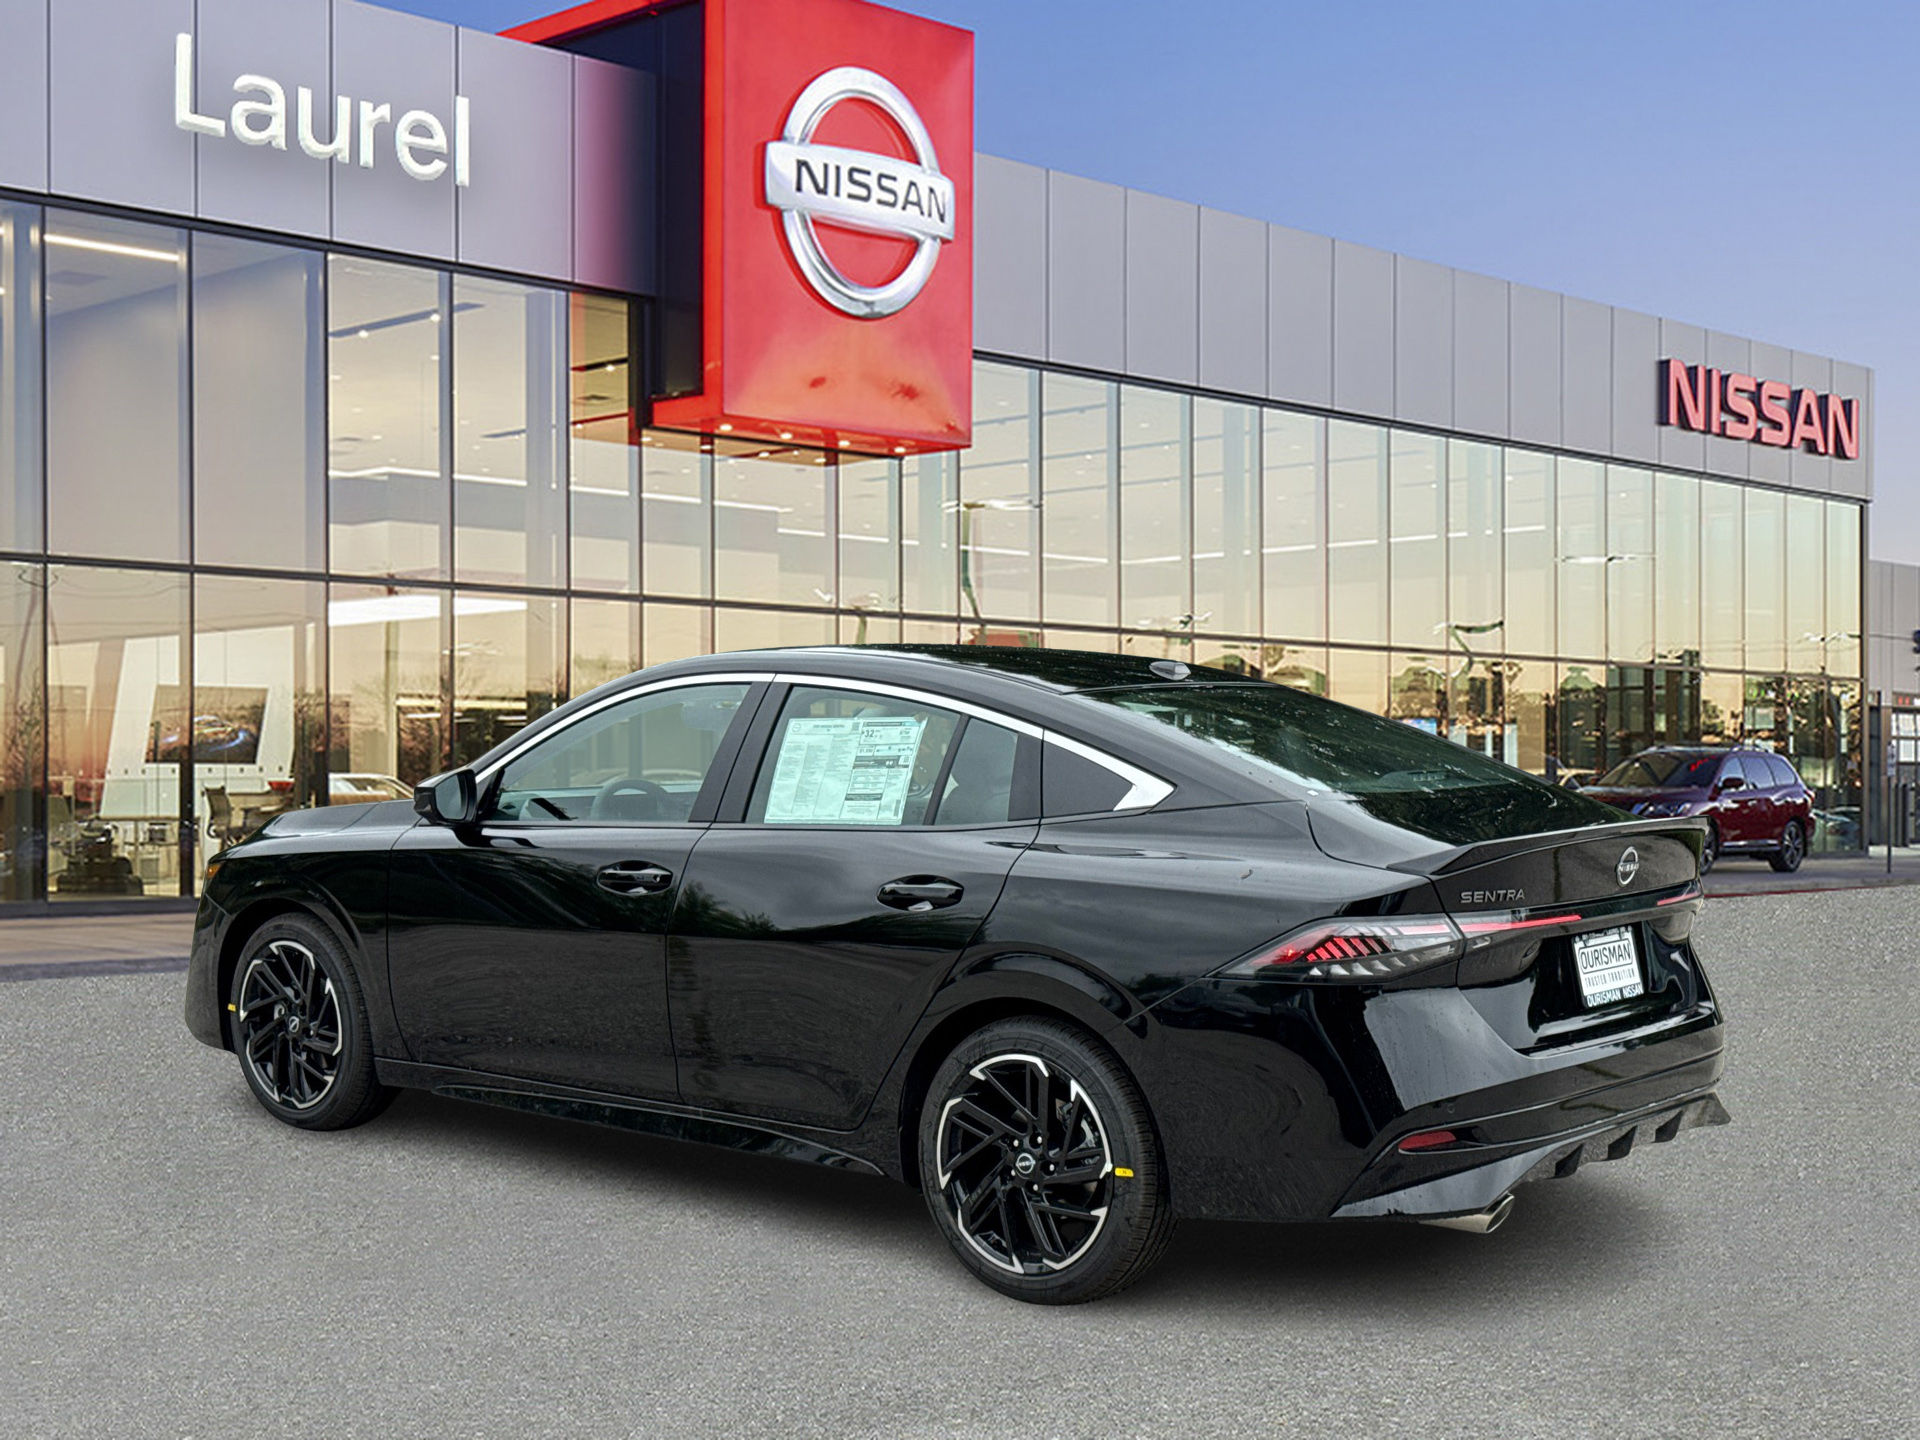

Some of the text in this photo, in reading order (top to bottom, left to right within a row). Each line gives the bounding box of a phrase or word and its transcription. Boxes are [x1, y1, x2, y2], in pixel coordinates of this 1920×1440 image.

[174, 32, 470, 188] Laurel
[794, 158, 946, 224] NISSAN
[1659, 358, 1860, 460] NISSAN
[1460, 888, 1526, 904] SENTRA
[1580, 943, 1631, 969] OURISMAN
[1586, 983, 1643, 1008] OURISMAN NISSAN
